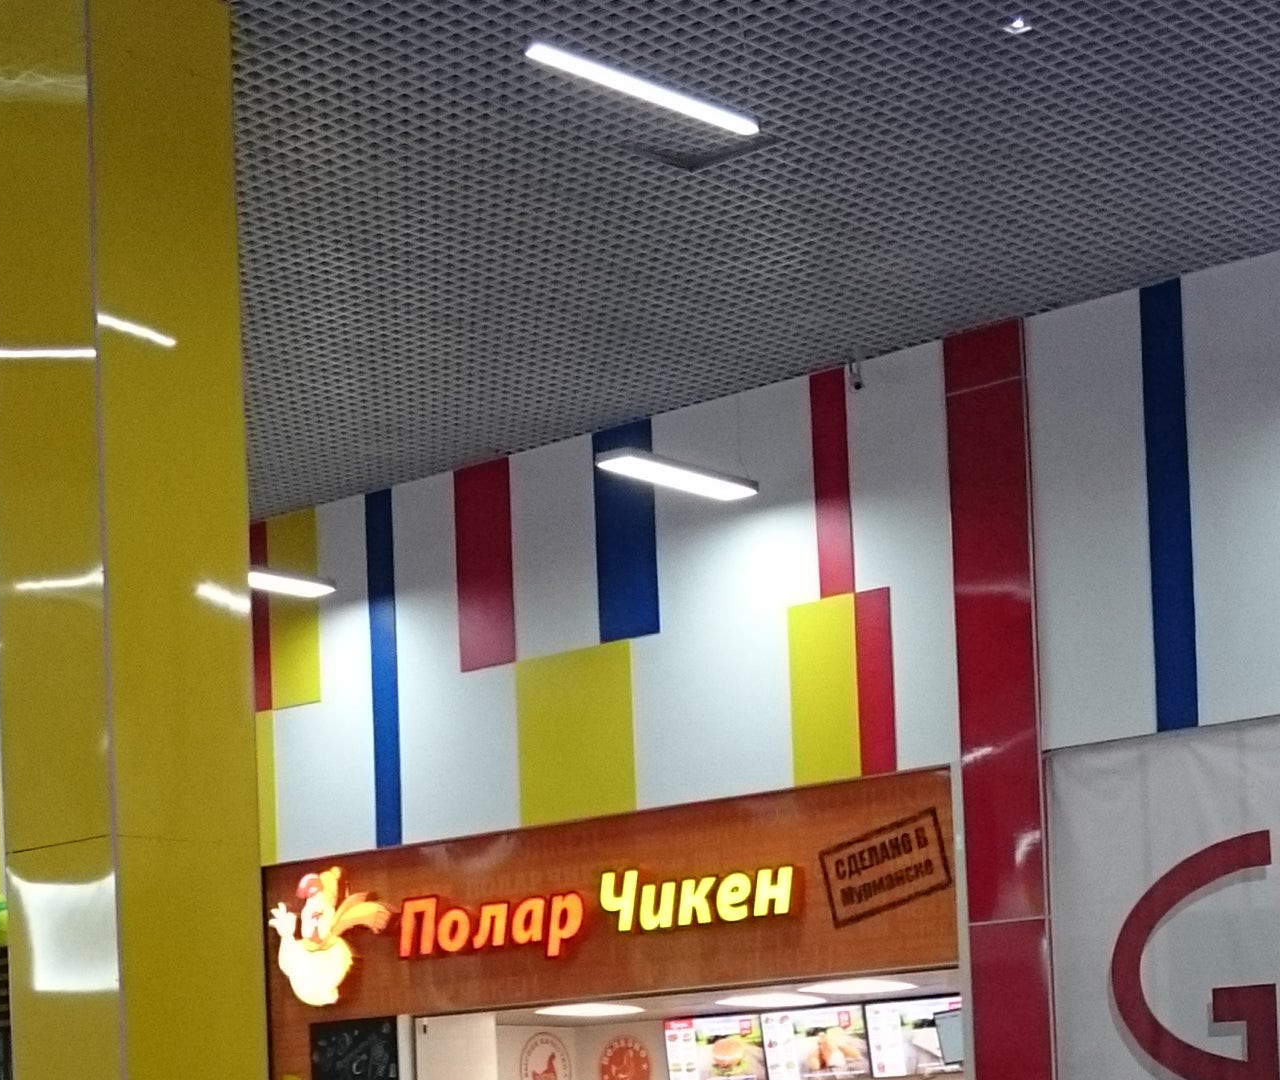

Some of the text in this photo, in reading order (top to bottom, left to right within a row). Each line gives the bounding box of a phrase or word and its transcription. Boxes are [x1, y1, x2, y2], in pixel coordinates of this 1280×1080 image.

[834, 826, 929, 880] СДЕЛАНО В
[840, 858, 935, 908] Мурманске
[398, 890, 585, 958] Полар
[597, 864, 795, 933] Чикен
